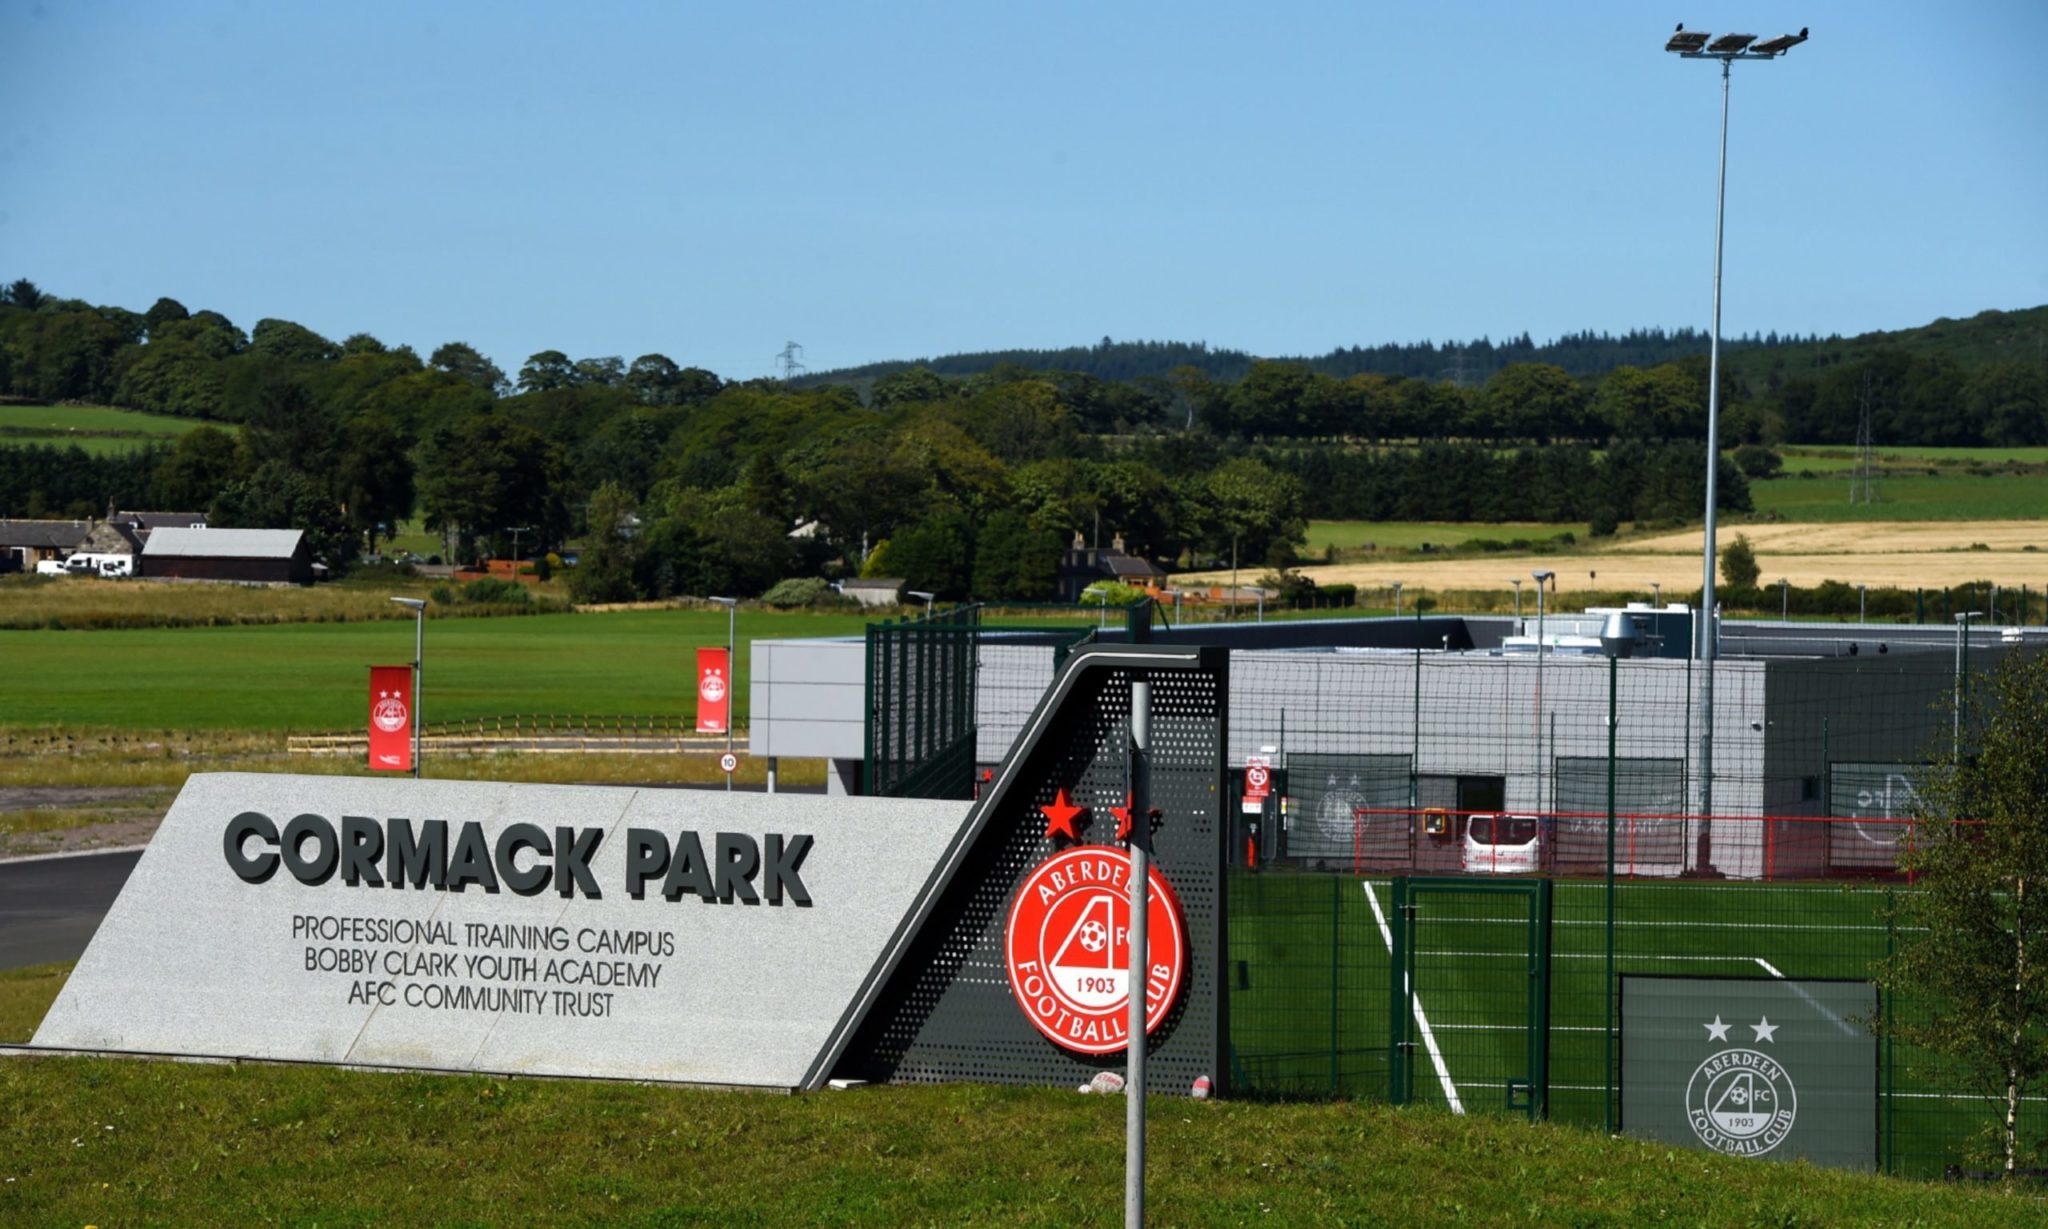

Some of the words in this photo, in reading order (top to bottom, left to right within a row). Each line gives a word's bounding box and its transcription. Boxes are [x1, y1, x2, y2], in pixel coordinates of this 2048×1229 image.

[723, 758, 735, 768] 10
[224, 811, 603, 899] CORMACK
[626, 828, 814, 907] PARK
[292, 915, 457, 946] PROFESSIONAL
[465, 923, 569, 951] TRAINING
[577, 928, 674, 957] CAMPUS
[305, 947, 377, 974] BOBBY
[384, 950, 458, 977] CLARK
[464, 954, 537, 982] YOUTH
[544, 958, 662, 988] ACADEMY
[1077, 977, 1115, 993] 1903
[348, 980, 396, 1006] AFC
[404, 983, 547, 1015] COMMUNITY
[552, 991, 614, 1017] TRUST
[1018, 960, 1126, 1041] FOOTBALL
[1146, 963, 1170, 1014] LUB
[1703, 1053, 1781, 1081] ABERDEEN
[1691, 1108, 1763, 1153] FOOTBALL
[1764, 1109, 1792, 1144] CLUB
[1729, 1118, 1754, 1127] 1903
